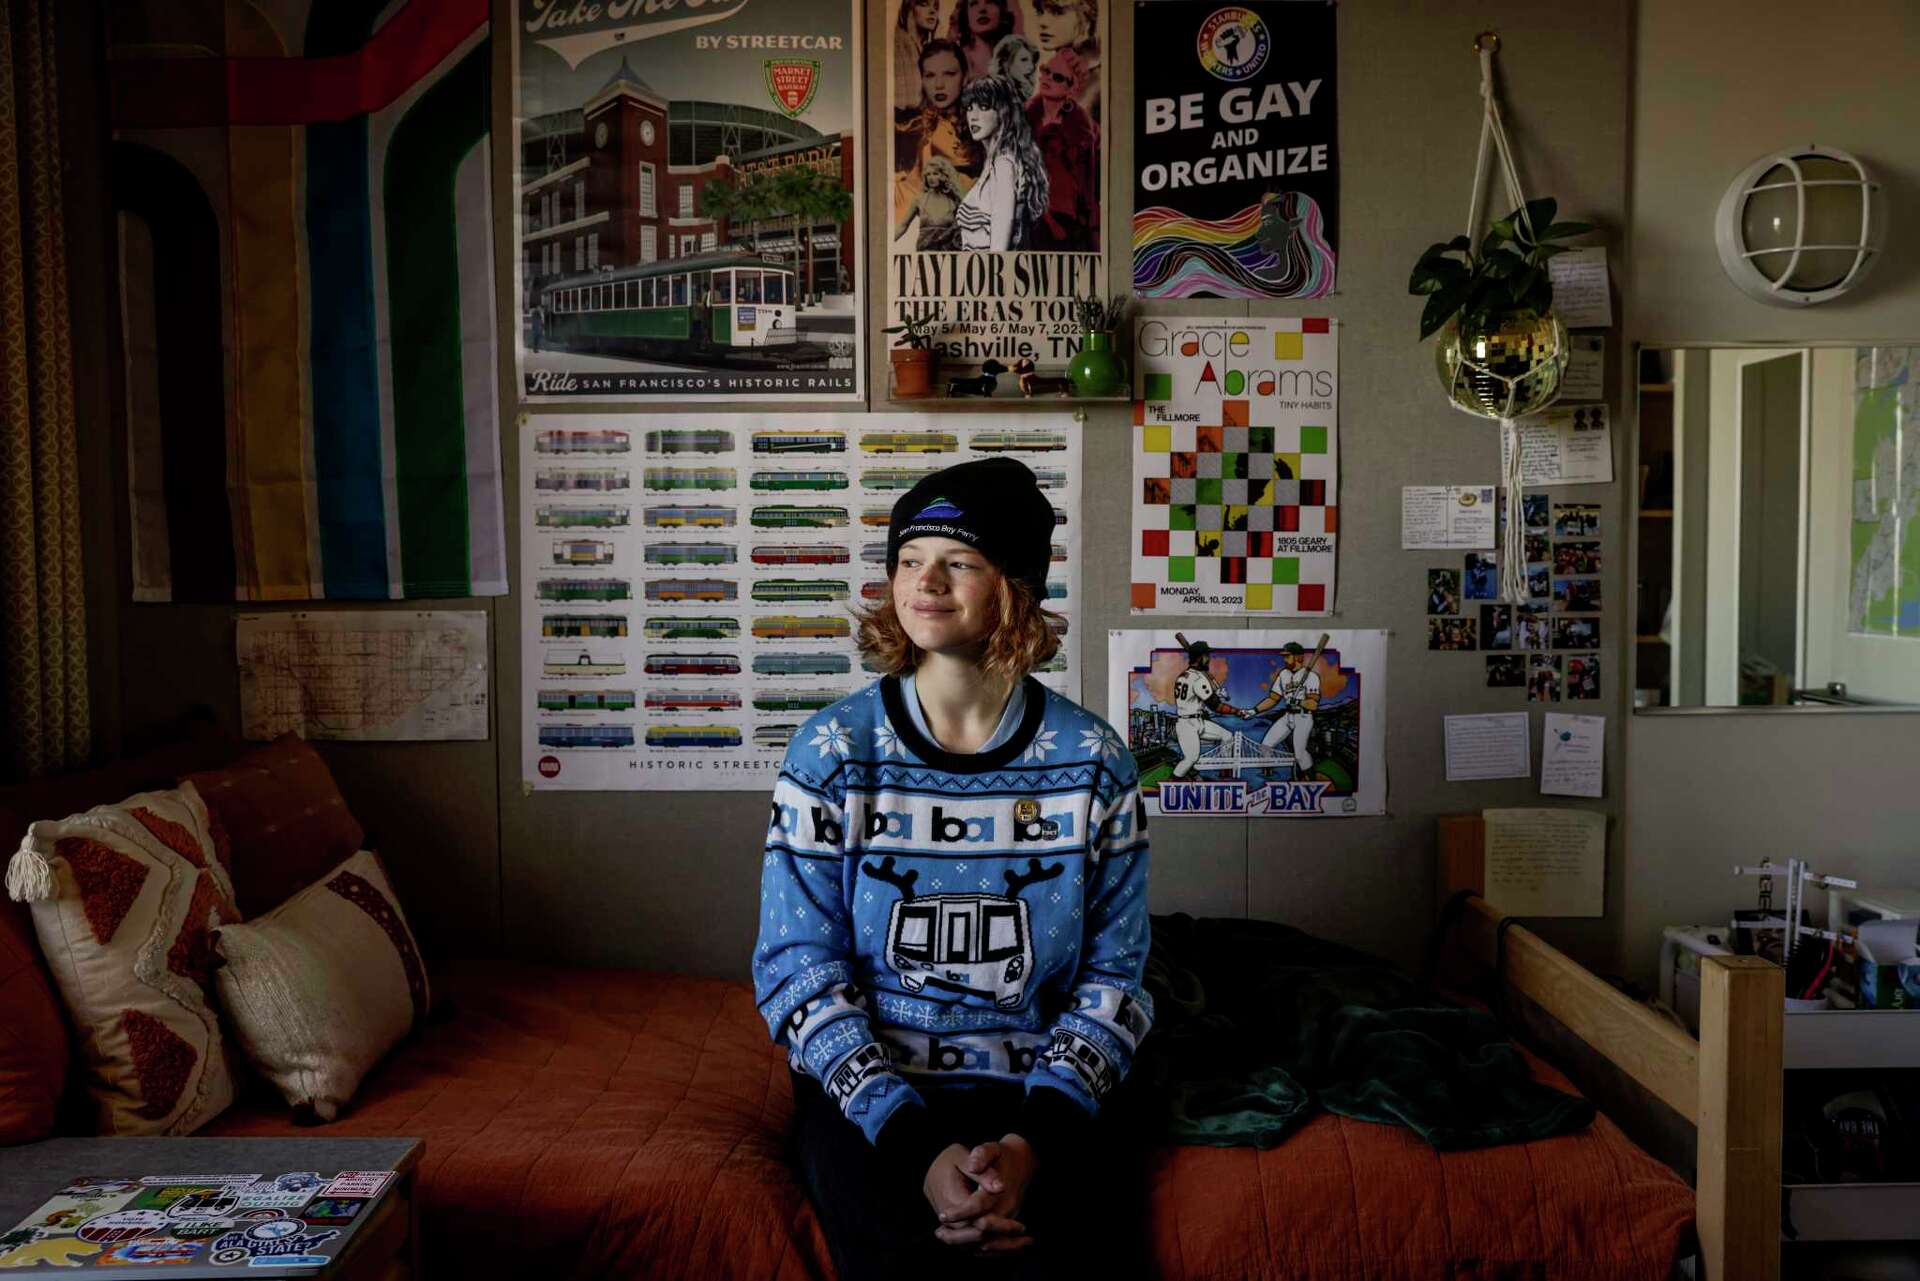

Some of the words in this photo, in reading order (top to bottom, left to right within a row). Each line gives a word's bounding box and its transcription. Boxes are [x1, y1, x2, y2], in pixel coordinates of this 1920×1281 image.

[696, 36, 721, 49] BY
[728, 35, 843, 50] STREETCAR
[773, 66, 811, 76] MARKET
[775, 76, 809, 84] STREET
[1145, 92, 1204, 134] BE
[1219, 79, 1322, 124] GAY
[1211, 129, 1259, 150] AND
[1140, 144, 1328, 191] ORGANIZE
[894, 254, 1005, 297] TAYLOR
[1014, 254, 1102, 297] SWIFT
[894, 301, 948, 321] THE
[957, 301, 1024, 321] ERAS
[1031, 301, 1080, 321] TOU
[913, 324, 938, 335] May
[942, 324, 956, 335] 5/
[960, 324, 985, 335] May
[990, 324, 1004, 335] 6/
[1009, 324, 1036, 335] May
[1040, 324, 1049, 336] 7,
[1139, 320, 1250, 357] Gracie
[917, 337, 1039, 361] Nashville,
[1047, 337, 1083, 357] TN
[528, 370, 578, 392] Ride
[582, 379, 612, 389] SAN
[619, 378, 721, 389] FRANCISCO'S
[729, 378, 801, 388] HISTORIC
[808, 378, 852, 388] RAILS
[1195, 360, 1333, 397] Abrams
[1148, 405, 1166, 414] THE
[1279, 401, 1299, 409] TINY
[1301, 401, 1332, 410] HABITS
[1156, 413, 1201, 422] FILLMORE
[910, 524, 940, 533] Francisco
[941, 525, 956, 534] Bay
[1298, 537, 1328, 545] GEARY
[1290, 545, 1333, 553] FILLMORE
[1160, 587, 1201, 596] MONDAY,
[1183, 596, 1208, 604] APRIL
[1210, 596, 1221, 605] 10,
[1222, 596, 1243, 604] 2023
[629, 761, 703, 769] HISTORIC
[1164, 784, 1244, 811] UNITE
[1271, 784, 1325, 811] BAY
